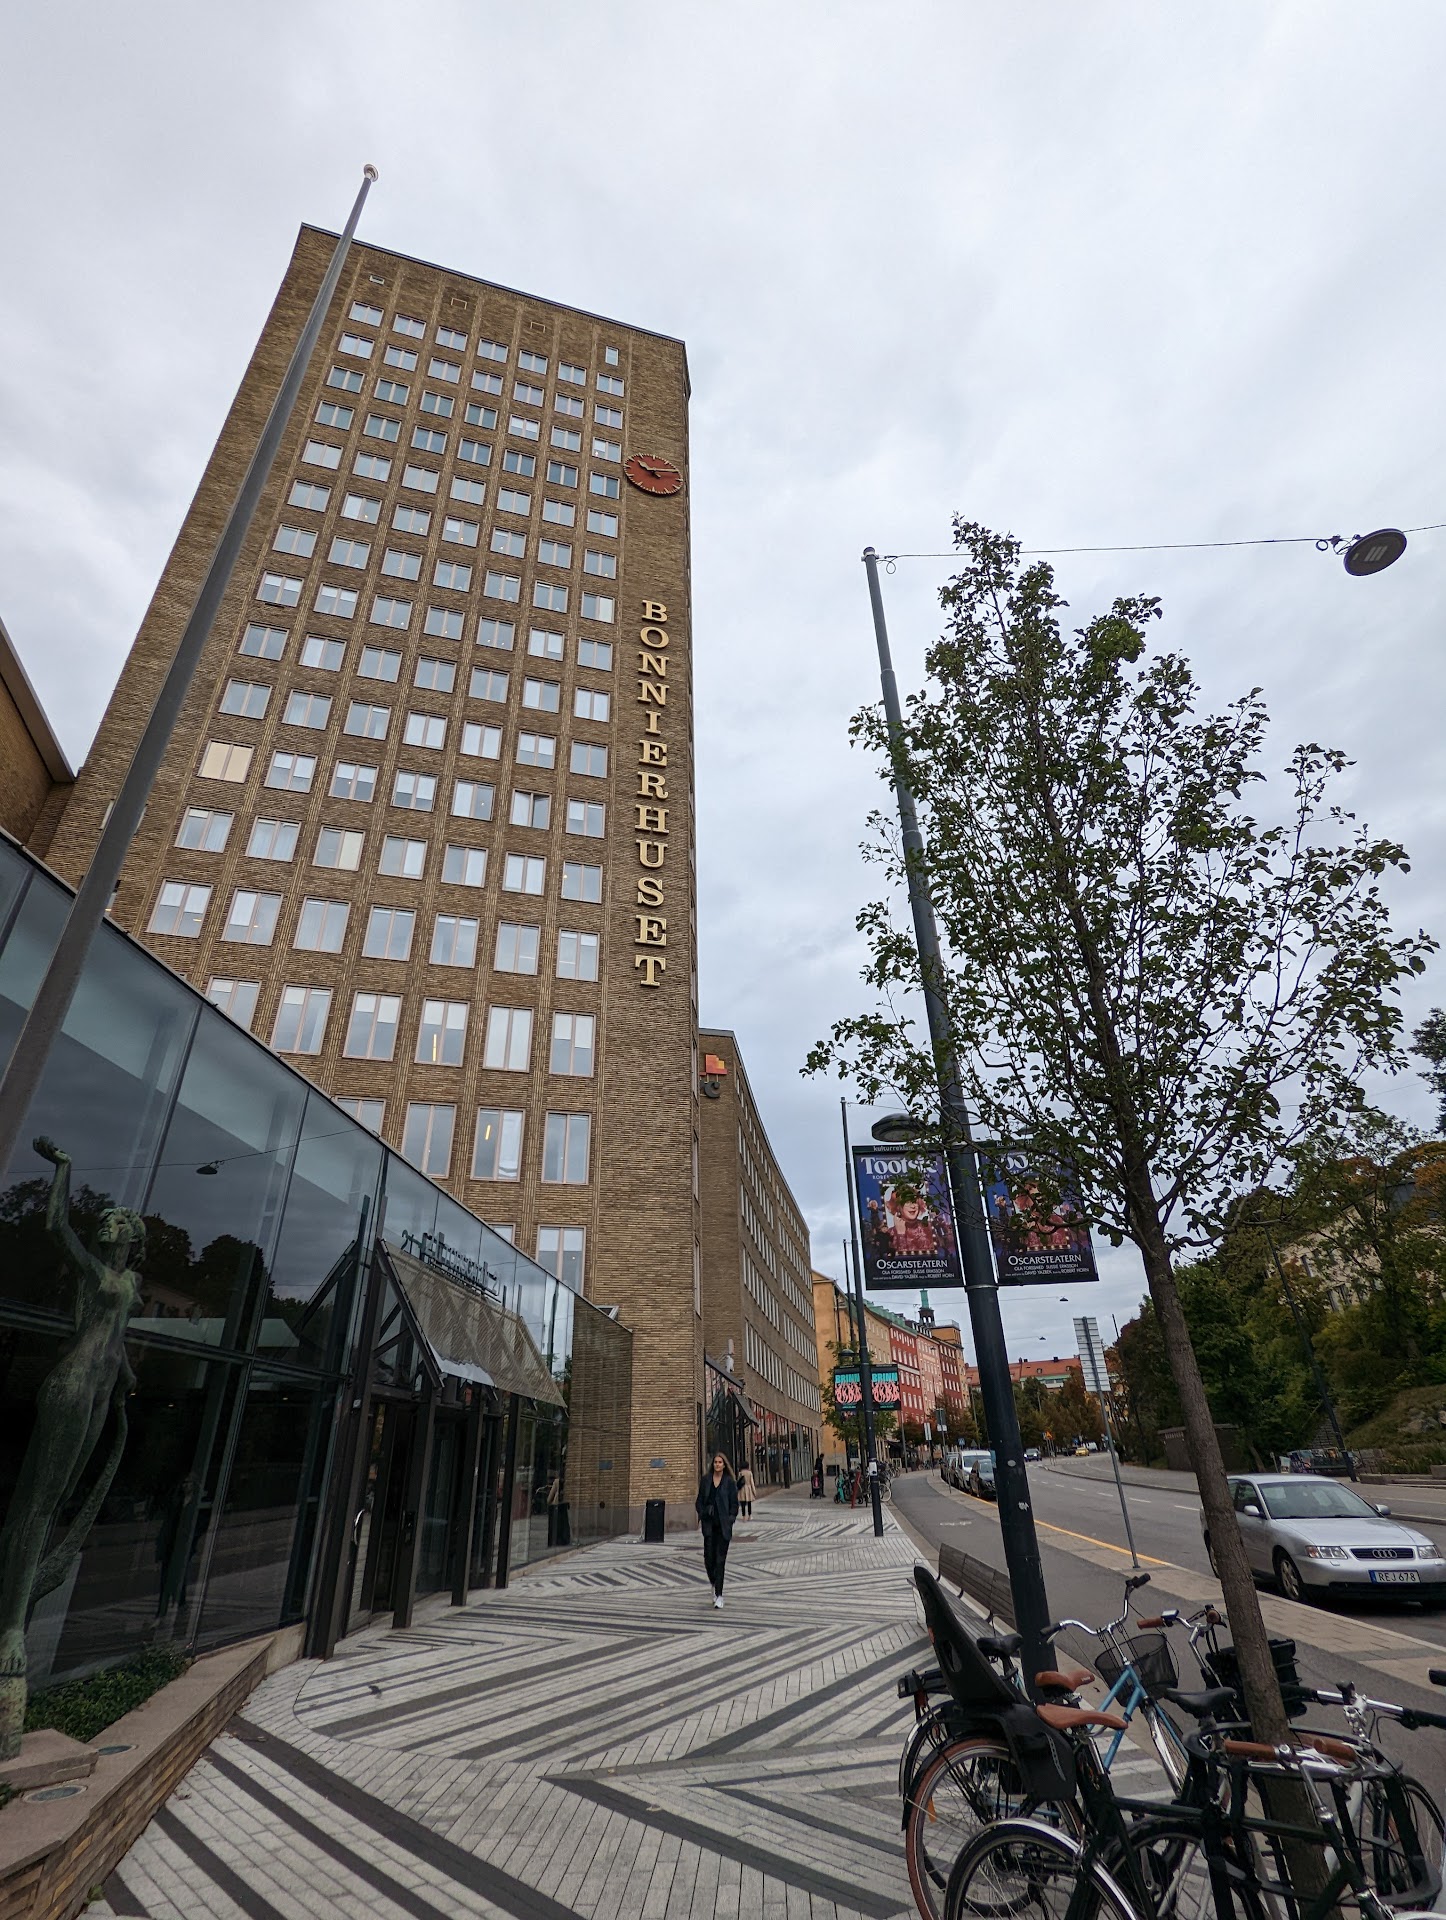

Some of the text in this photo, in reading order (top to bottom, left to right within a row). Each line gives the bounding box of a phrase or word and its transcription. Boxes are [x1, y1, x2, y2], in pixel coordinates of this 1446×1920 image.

[635, 600, 670, 988] BONNIERHUSET
[1379, 1572, 1415, 1582] REJ 678
